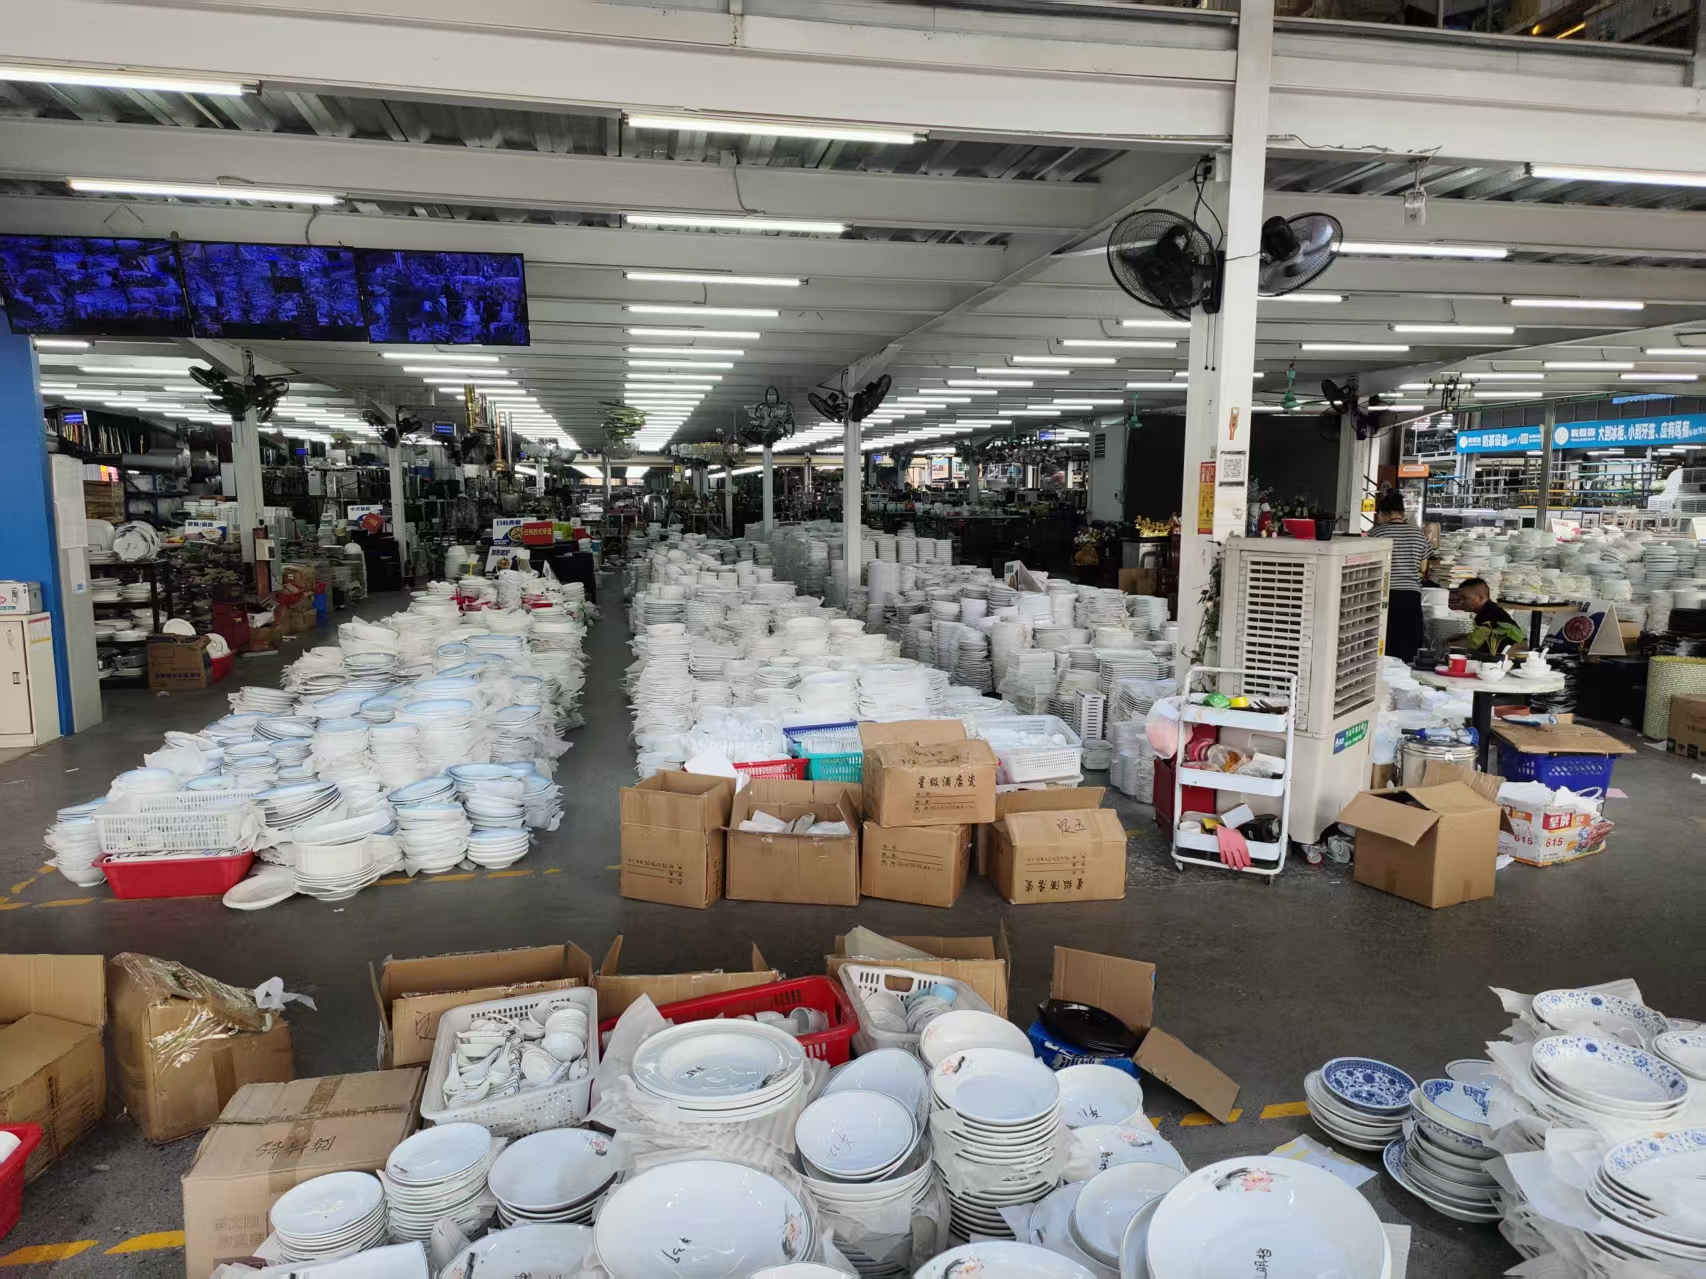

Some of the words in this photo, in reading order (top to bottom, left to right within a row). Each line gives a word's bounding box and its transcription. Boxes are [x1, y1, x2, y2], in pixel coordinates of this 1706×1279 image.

[918, 773, 976, 789] 星级酒店瓷
[1513, 833, 1534, 846] 615
[1545, 837, 1564, 848] 615
[1024, 877, 1085, 893] 星级酒店瓷
